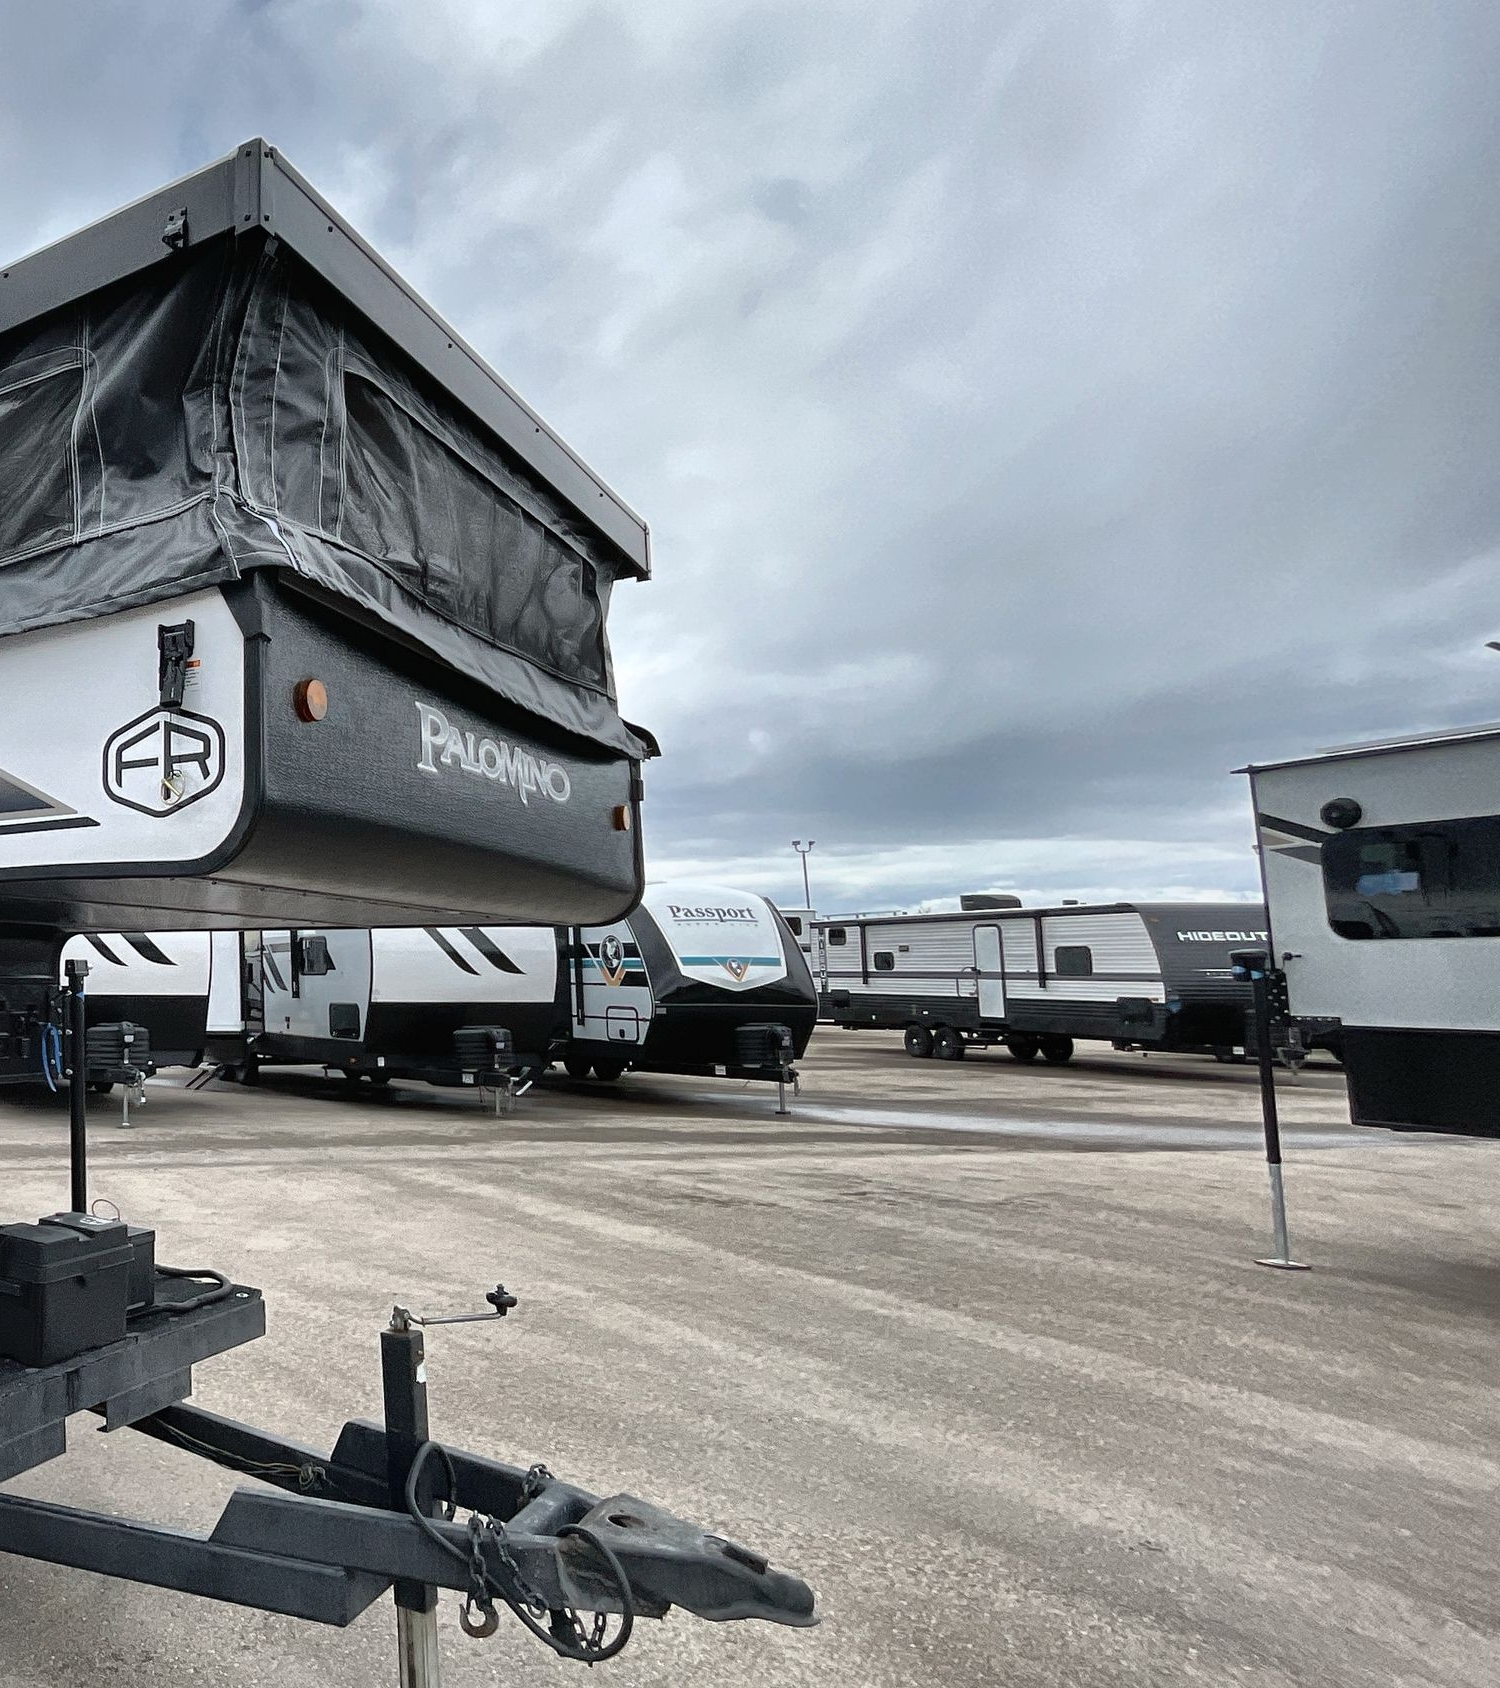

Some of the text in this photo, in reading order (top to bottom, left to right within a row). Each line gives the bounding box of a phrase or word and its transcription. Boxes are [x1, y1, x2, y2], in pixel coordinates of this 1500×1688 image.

[415, 701, 570, 807] PALOMINO
[666, 905, 756, 923] Passport
[1177, 931, 1268, 942] HIDEOUT
